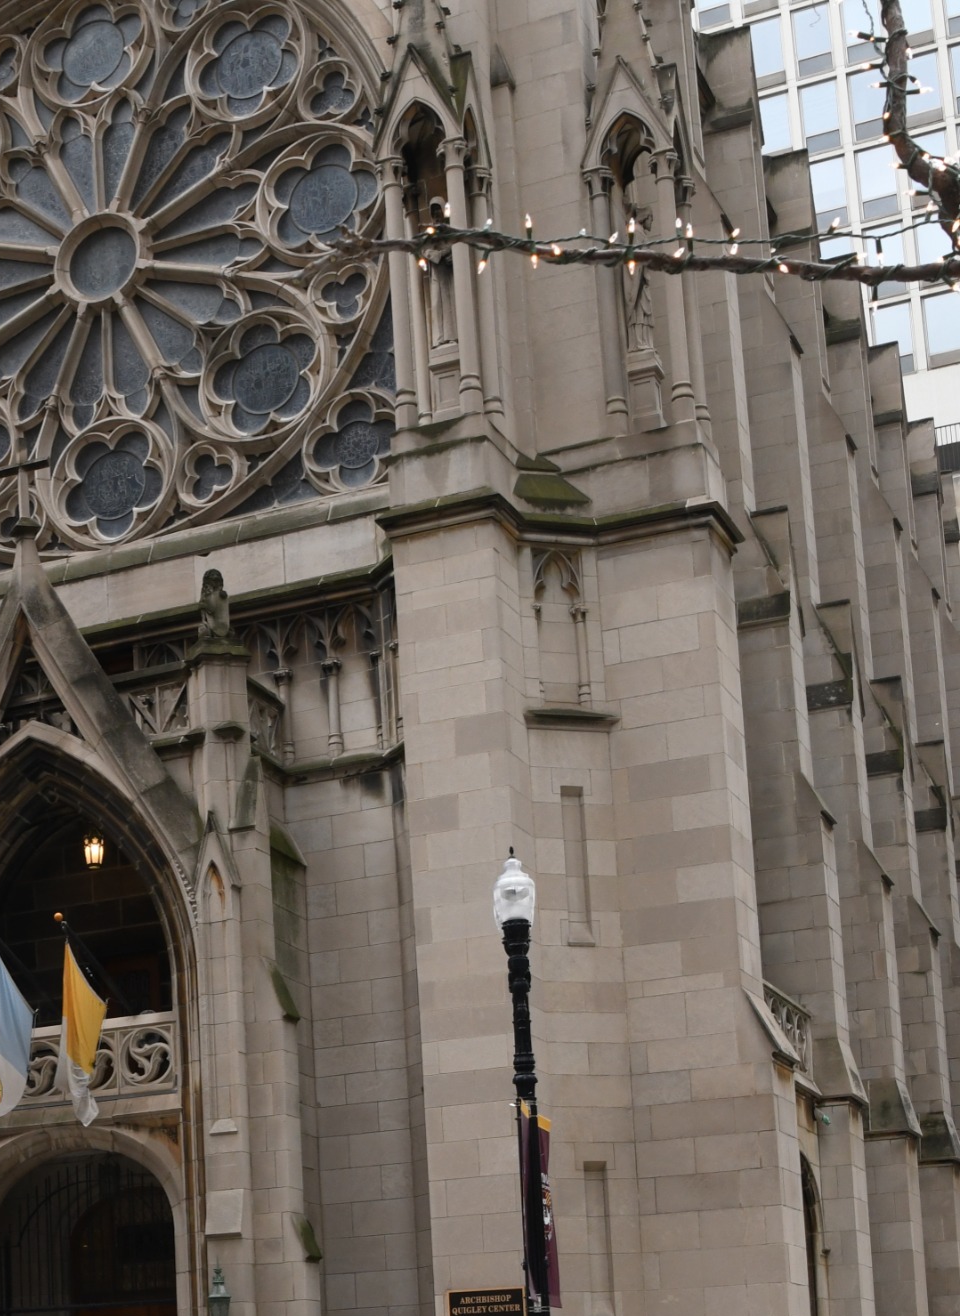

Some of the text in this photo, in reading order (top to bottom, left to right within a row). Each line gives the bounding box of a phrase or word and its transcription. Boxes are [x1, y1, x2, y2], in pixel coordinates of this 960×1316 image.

[460, 1294, 511, 1304] ARCHBISHOP
[452, 1304, 520, 1315] QUIGLEY CENTER
